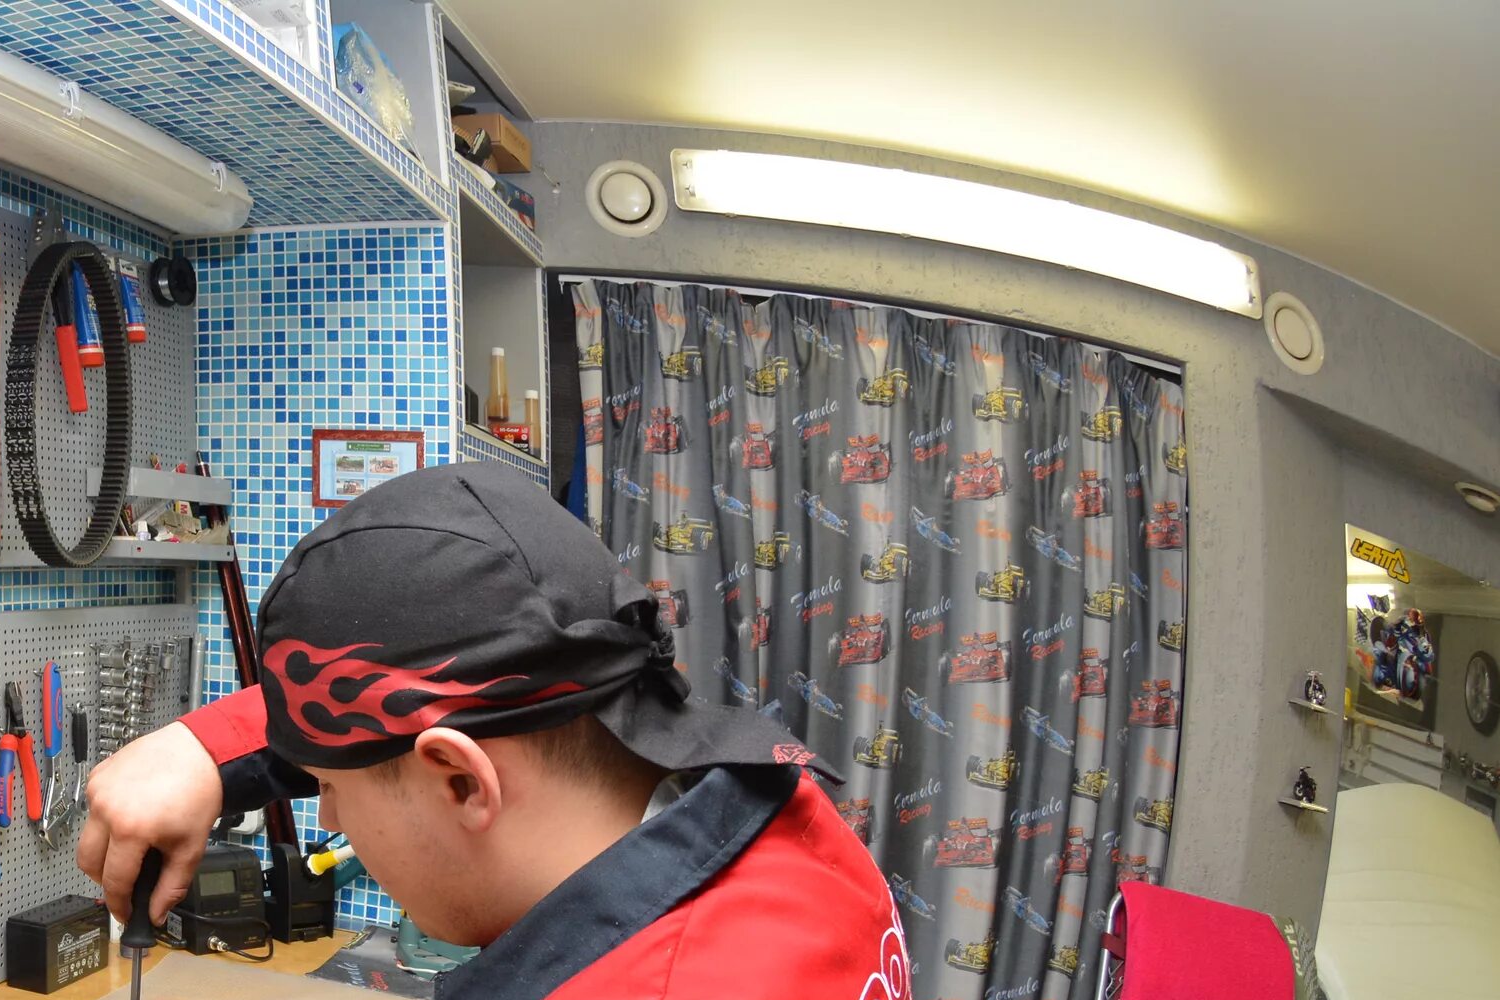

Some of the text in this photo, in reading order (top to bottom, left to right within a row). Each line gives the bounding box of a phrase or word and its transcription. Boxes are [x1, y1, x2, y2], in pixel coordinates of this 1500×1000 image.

[904, 597, 952, 629] Formula
[1022, 612, 1076, 651] Formula
[894, 778, 942, 815] Formula
[899, 804, 932, 825] Racing
[1010, 797, 1064, 833] Formula
